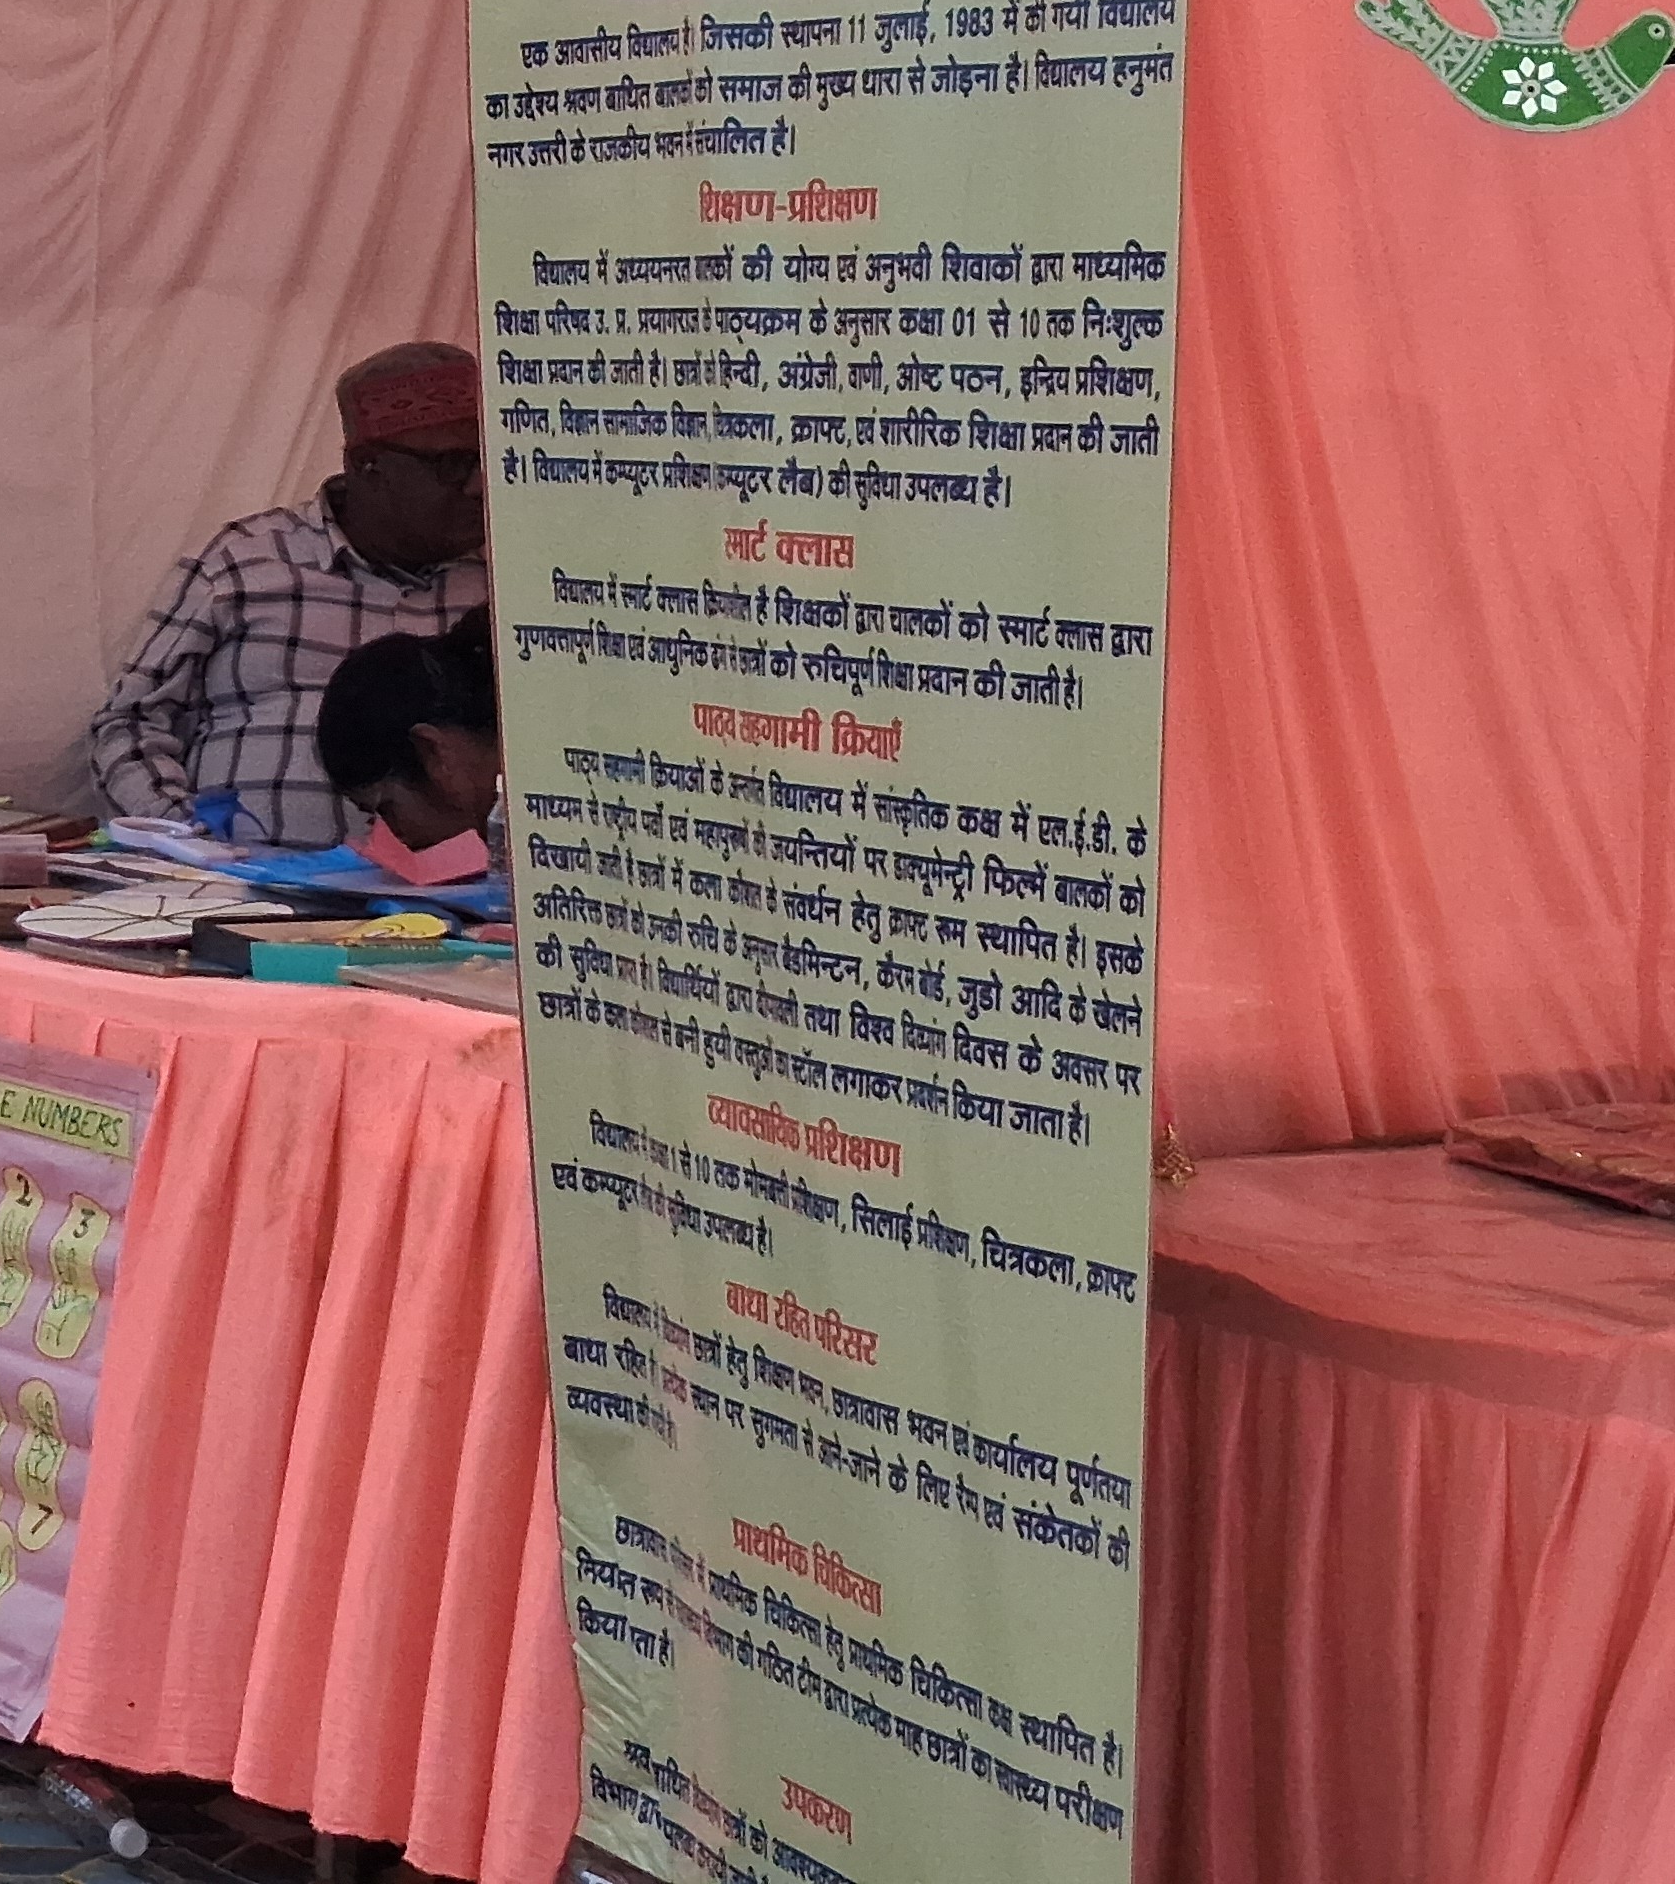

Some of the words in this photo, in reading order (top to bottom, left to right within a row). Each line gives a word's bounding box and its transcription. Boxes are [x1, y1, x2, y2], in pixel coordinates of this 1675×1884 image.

[520, 41, 548, 69] एक
[555, 25, 622, 65] आवासीय
[627, 23, 679, 59] विद्यालय
[700, 12, 774, 52] जिसकी
[780, 18, 842, 48] स्थापना
[848, 13, 865, 43] 11
[945, 6, 993, 38] 1983
[485, 94, 509, 120] का
[513, 82, 559, 121] उद्देश्य
[563, 87, 601, 115] श्रवण
[604, 74, 651, 112] बाधित
[695, 66, 713, 103] को
[717, 75, 783, 103] समाज
[788, 62, 812, 101] की
[815, 70, 857, 111] मुख्य
[862, 68, 902, 96] धारा
[907, 54, 926, 95] से
[1005, 51, 1028, 94] है।
[1034, 49, 1108, 90] विद्यालय
[1112, 43, 1174, 97] हनुमंत
[486, 142, 525, 168] नगर
[527, 129, 567, 166] उत्तरी
[569, 128, 586, 164] के
[589, 123, 651, 163] राजकीय
[771, 115, 795, 157] है।
[699, 178, 877, 224] शिक्षण-प्रशिक्षण
[742, 243, 774, 282] की
[783, 244, 830, 283] योग्य
[837, 245, 859, 283] एवं
[865, 242, 932, 293] अनुभवी
[1030, 253, 1065, 286] द्वारा
[1072, 239, 1166, 282] माध्यमिक
[809, 297, 828, 336] के
[834, 308, 892, 348] अनुसार
[899, 308, 945, 336] कक्षा
[953, 307, 975, 337] 01
[987, 298, 1011, 339] से
[1020, 307, 1040, 340] 10
[1046, 309, 1076, 338] तक
[950, 364, 1011, 399] पठन,
[1075, 355, 1160, 402] प्रशिक्षण,
[879, 405, 962, 447] शारीरिक
[968, 409, 1026, 452] शिक्षा
[1032, 423, 1073, 452] प्रदान
[1077, 411, 1105, 453] की
[1110, 413, 1160, 456] जाती
[983, 465, 1011, 508] है।
[775, 532, 854, 569] क्लास
[1110, 624, 1154, 657] द्वारा
[983, 854, 1048, 902] फिल्में
[1054, 869, 1113, 912] बालकों
[1119, 874, 1146, 917] को
[975, 916, 1058, 962] स्थापित
[953, 1021, 1010, 1070] दिवस
[1052, 1049, 1109, 1090] अवसर
[23, 1094, 124, 1149] NUMBERS
[804, 1117, 901, 1177] प्रशिक्षण
[16, 1173, 34, 1208] 2
[71, 1208, 97, 1239] 3
[981, 1226, 1081, 1292] चित्रकला,
[813, 1308, 878, 1366] परिसर
[831, 1387, 900, 1440] छात्रावास
[973, 1433, 1058, 1486] कार्यालय
[30, 1502, 54, 1536] 7
[1012, 1496, 1102, 1559] संकेतकों
[729, 1518, 808, 1580] प्राथमिक
[812, 1541, 881, 1617] चिकित्सा
[922, 1726, 969, 1772] छात्रों
[776, 1775, 852, 1849] उपकरण
